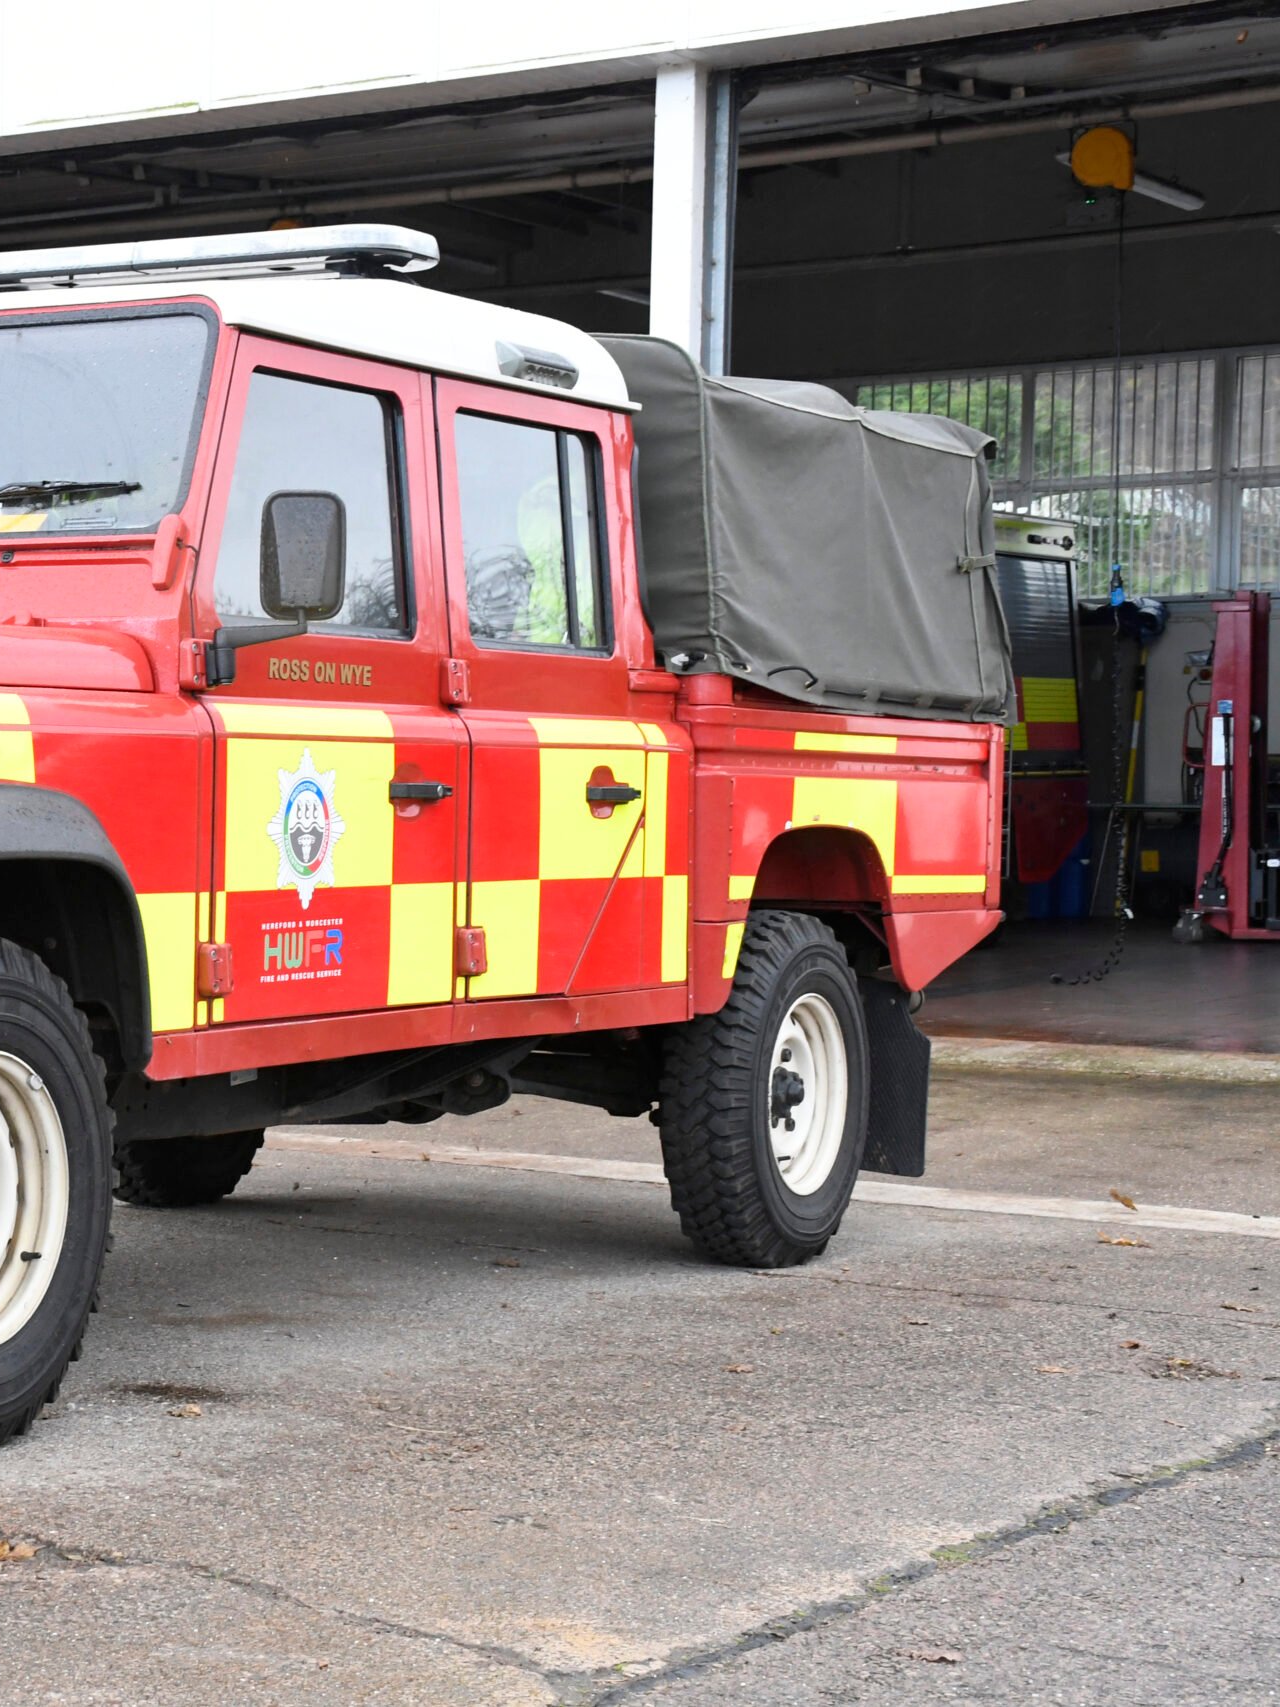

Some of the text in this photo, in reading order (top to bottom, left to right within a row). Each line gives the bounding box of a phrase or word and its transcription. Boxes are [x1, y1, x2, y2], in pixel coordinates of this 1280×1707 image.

[268, 657, 373, 686] ROSS ON WYE
[261, 921, 296, 930] HEREFORD
[305, 918, 343, 927] WORCESTER
[263, 929, 343, 971] HWFR
[260, 969, 342, 983] FIRE AND RESCUE SERVICE
